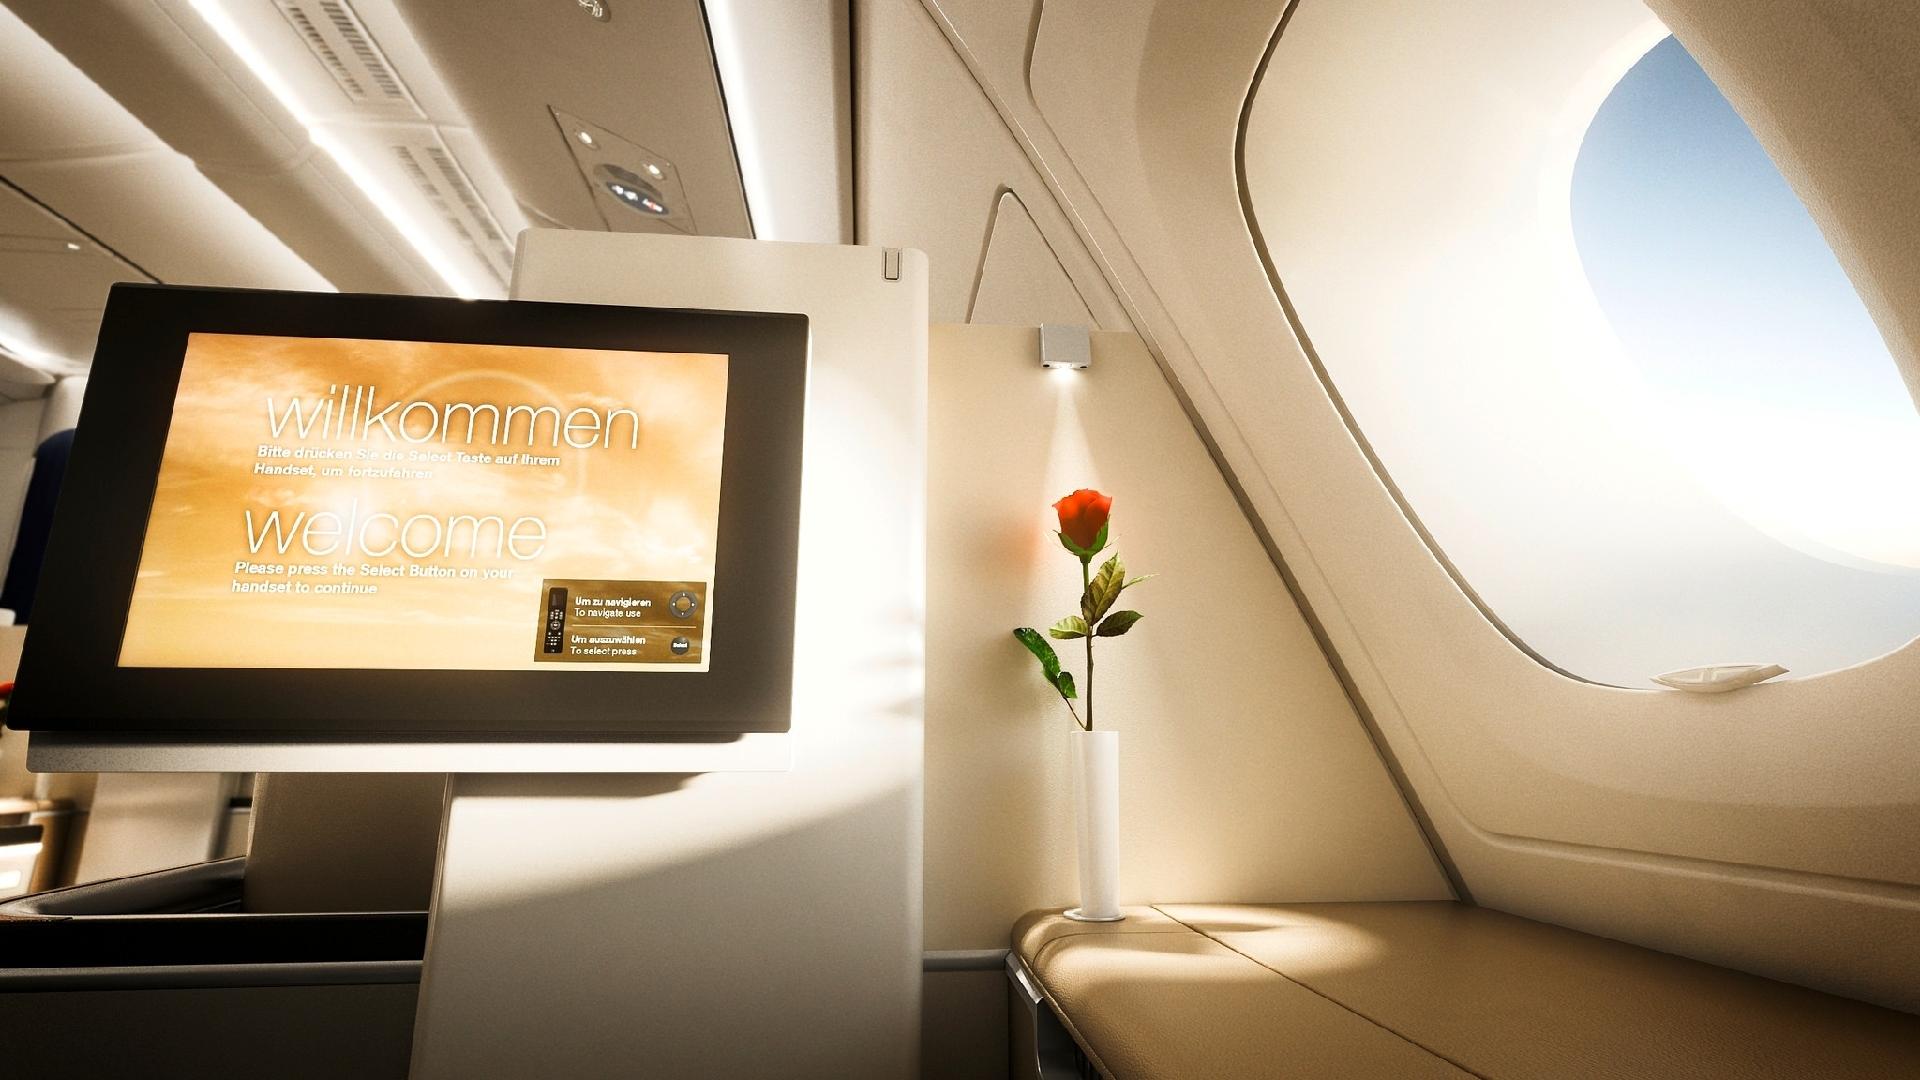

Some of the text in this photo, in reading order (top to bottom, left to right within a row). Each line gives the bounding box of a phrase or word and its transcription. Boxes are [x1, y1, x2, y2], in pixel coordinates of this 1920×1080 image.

[266, 383, 640, 451] willkommen
[257, 445, 561, 466] Bitte drücken Sie die Select Taste auf Ihrem
[254, 462, 433, 479] Handset, um fortzufahren
[245, 498, 547, 561] welcome
[234, 561, 512, 580] Please press the Select Button on your
[231, 580, 378, 594] handset to continue
[575, 596, 591, 606] Um
[605, 597, 652, 608] navigieren
[574, 608, 641, 619] To navigate use
[571, 635, 587, 644] Um
[570, 646, 637, 656] To select press
